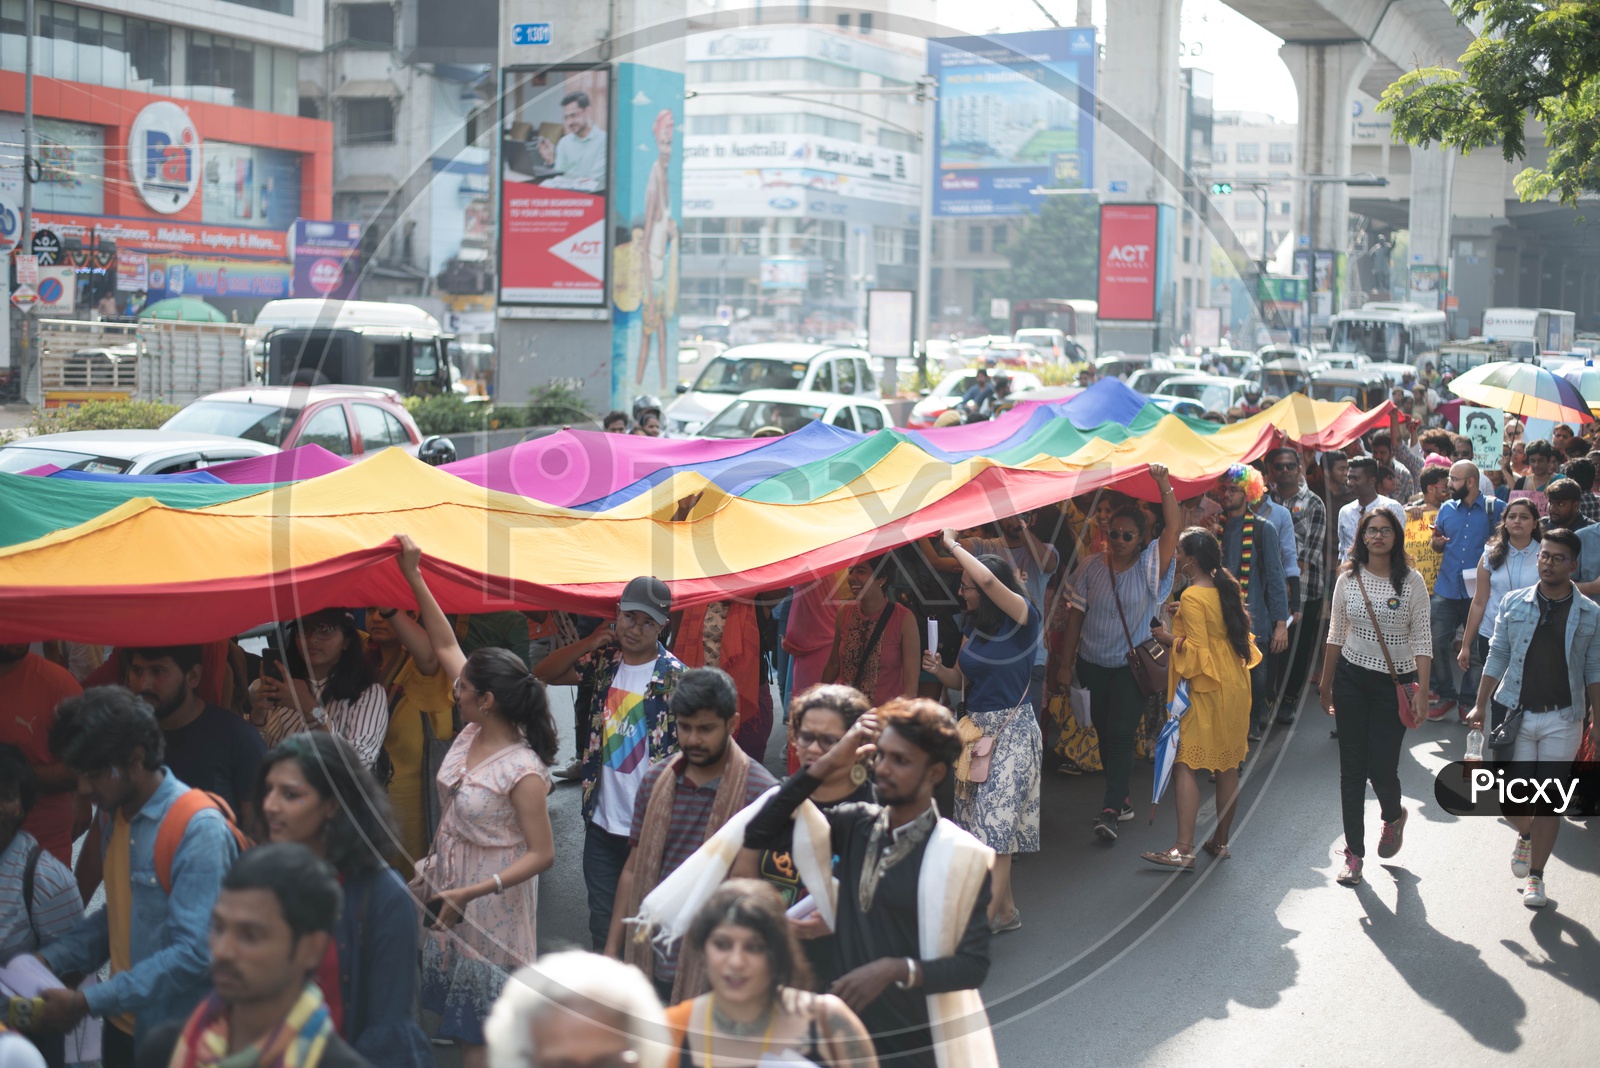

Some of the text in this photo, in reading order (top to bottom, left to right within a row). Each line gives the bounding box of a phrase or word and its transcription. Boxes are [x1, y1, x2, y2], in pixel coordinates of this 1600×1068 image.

[146, 128, 194, 182] Pai
[570, 241, 601, 254] ACT
[1108, 244, 1149, 262] ACT
